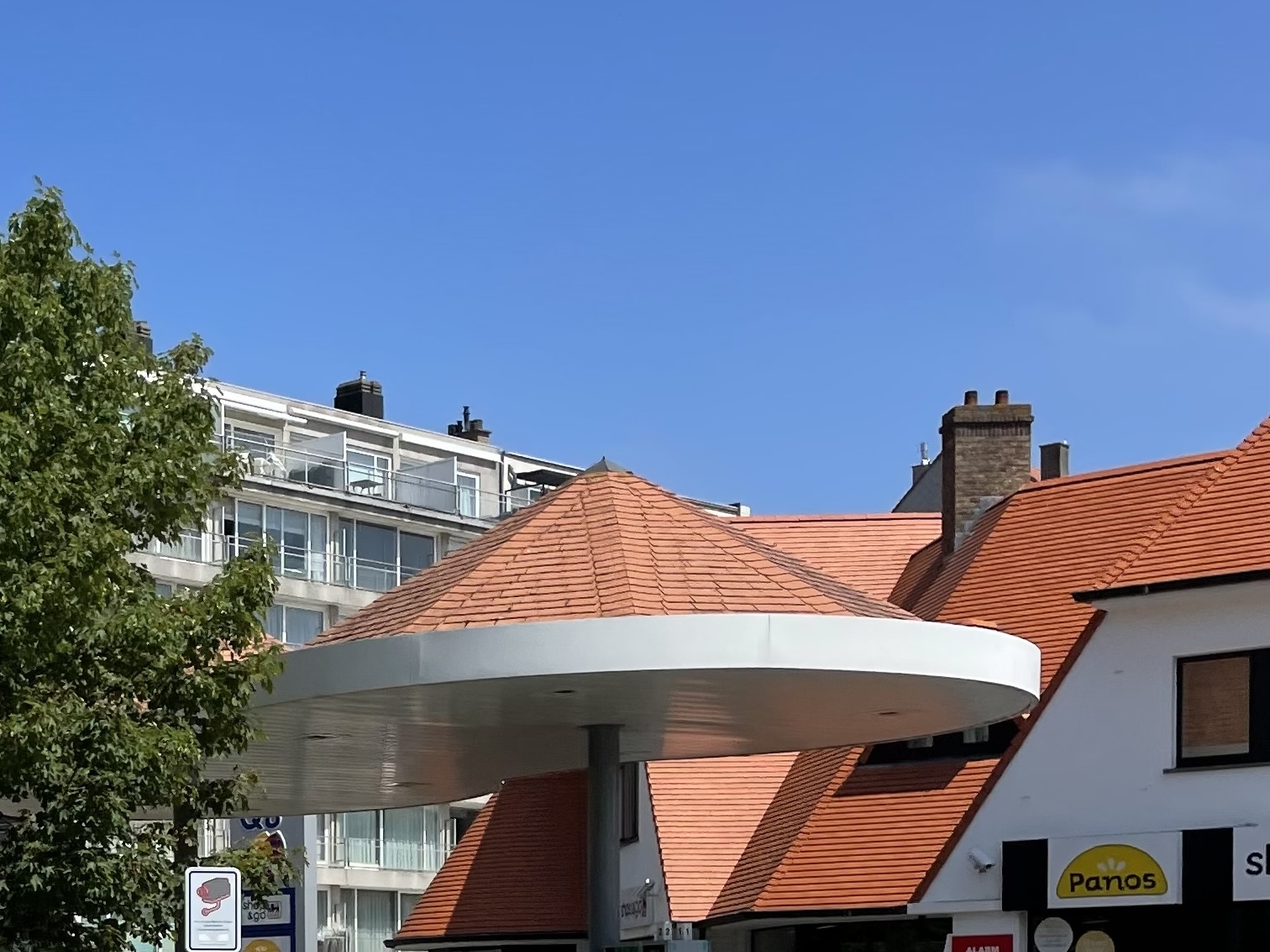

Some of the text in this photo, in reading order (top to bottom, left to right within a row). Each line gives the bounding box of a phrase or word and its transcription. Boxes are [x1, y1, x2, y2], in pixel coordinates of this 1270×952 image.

[1245, 844, 1270, 875] s
[1070, 873, 1157, 893] Panos
[247, 911, 267, 922] &go
